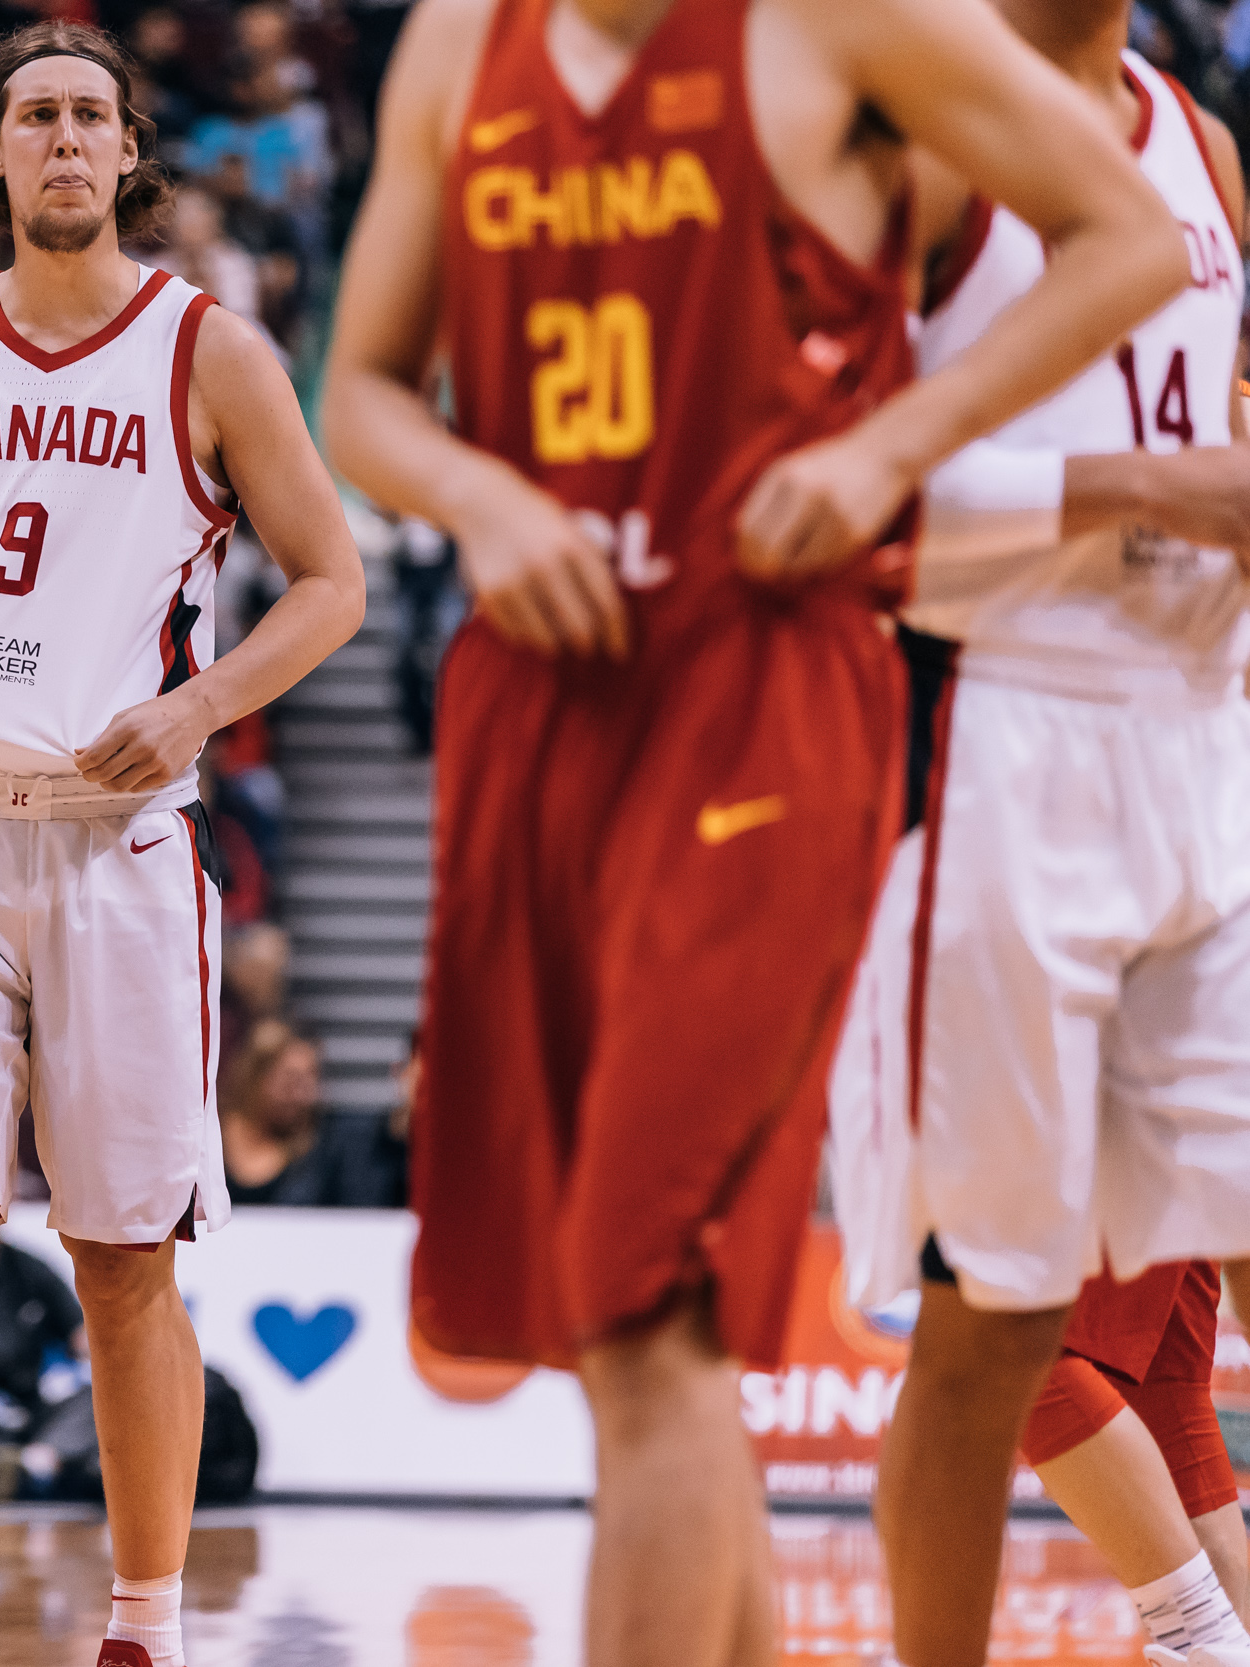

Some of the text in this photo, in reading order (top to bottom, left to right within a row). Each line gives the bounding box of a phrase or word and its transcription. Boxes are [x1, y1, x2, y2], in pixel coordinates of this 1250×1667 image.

[466, 152, 722, 250] CHINA
[527, 296, 653, 464] 20
[1117, 341, 1193, 448] 14
